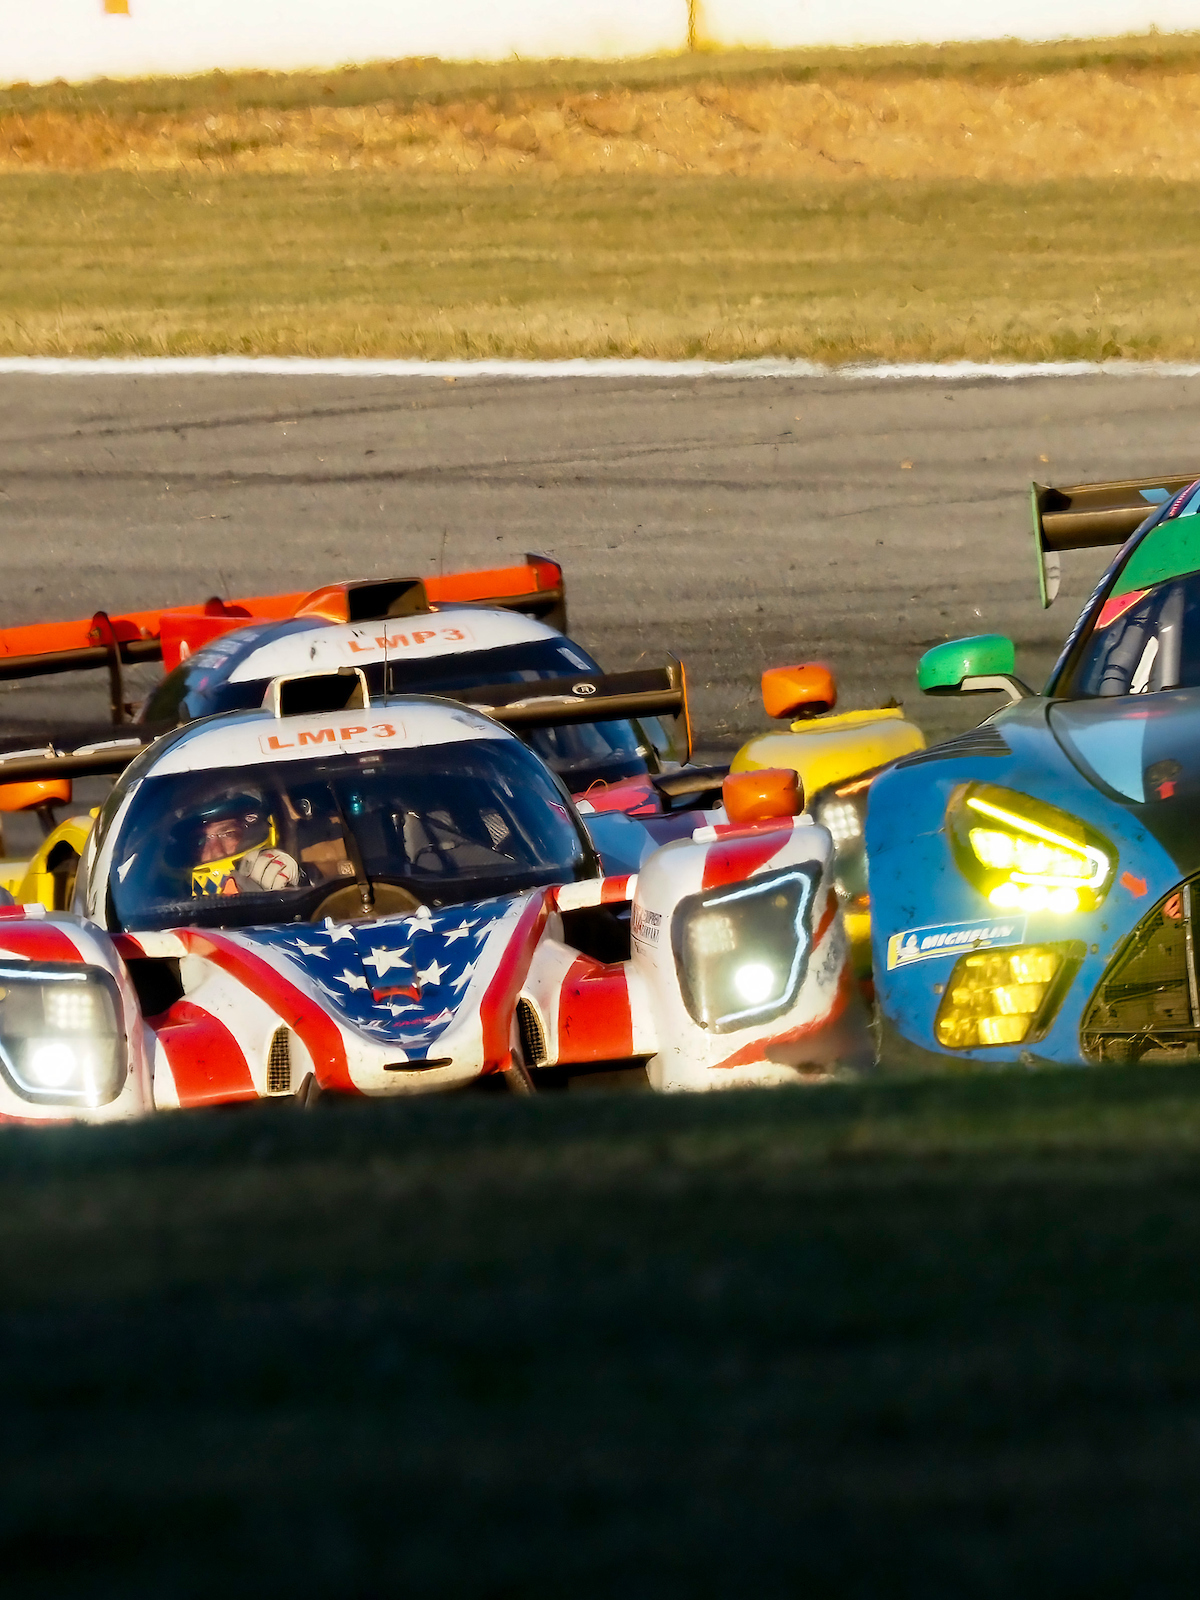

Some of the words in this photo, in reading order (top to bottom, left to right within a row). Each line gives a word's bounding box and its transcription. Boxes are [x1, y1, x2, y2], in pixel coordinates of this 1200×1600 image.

[347, 627, 466, 653] LMP3
[266, 723, 397, 750] LMP3
[920, 925, 1015, 951] MICHELIN
